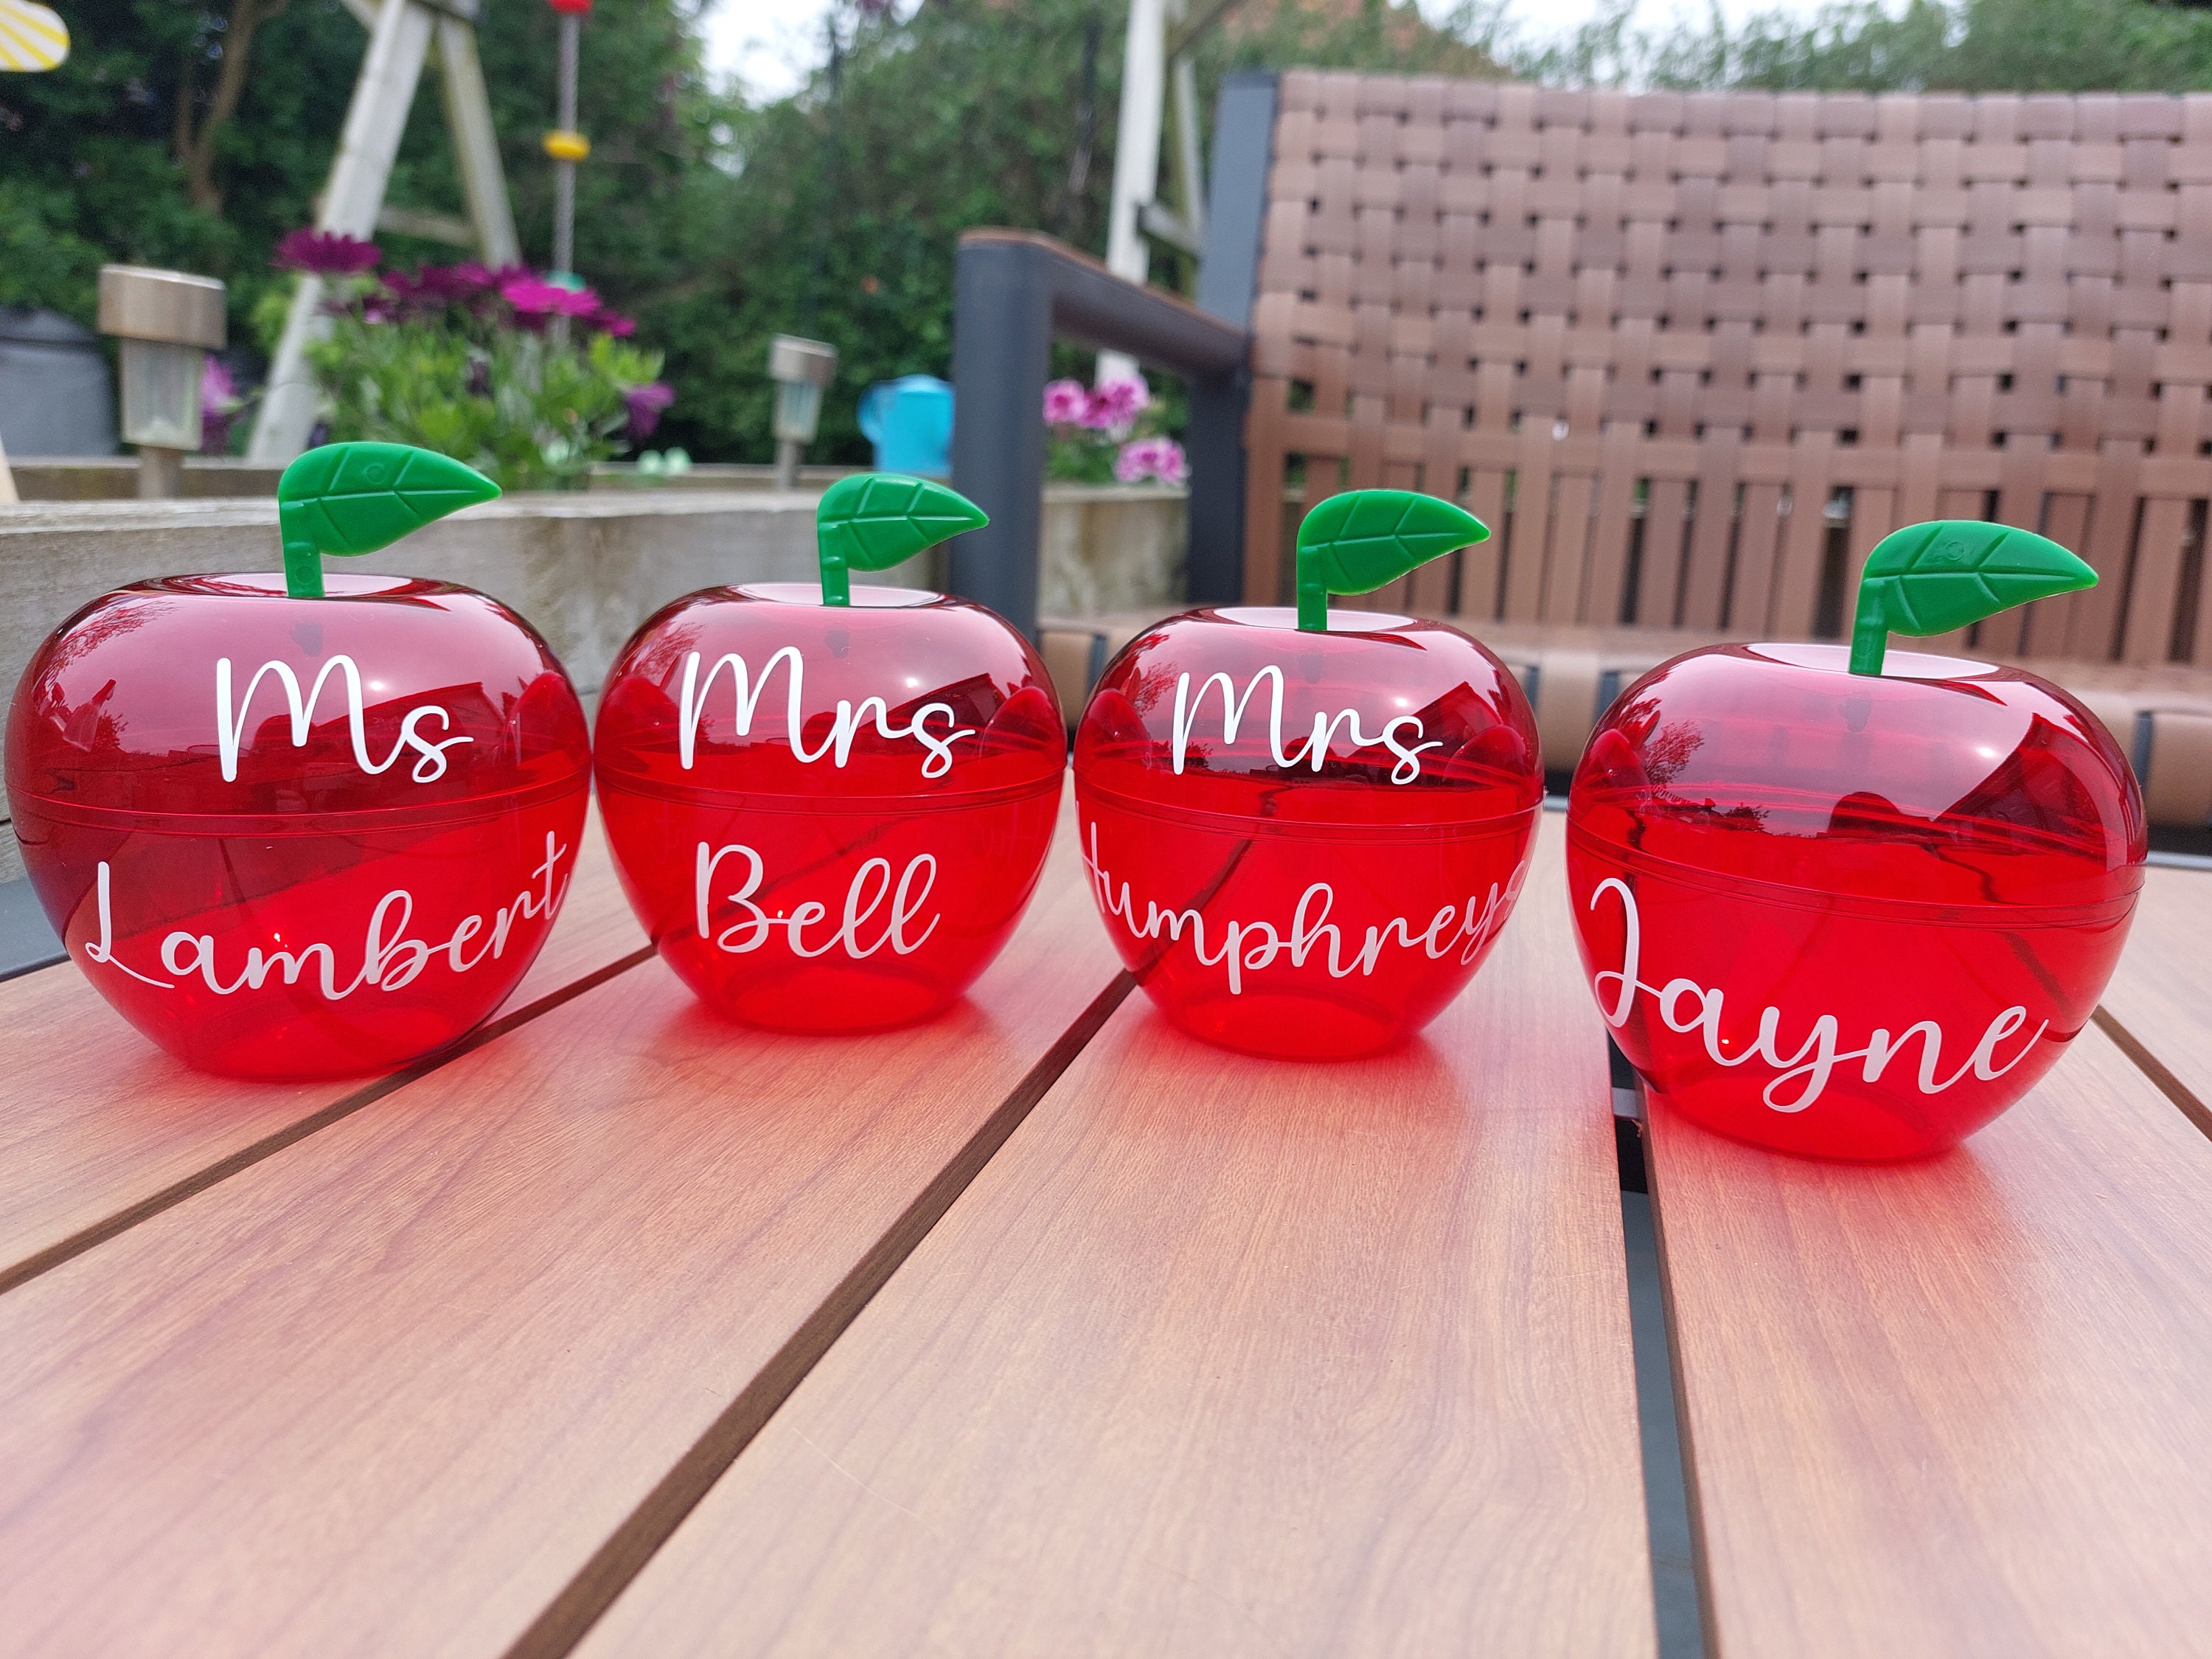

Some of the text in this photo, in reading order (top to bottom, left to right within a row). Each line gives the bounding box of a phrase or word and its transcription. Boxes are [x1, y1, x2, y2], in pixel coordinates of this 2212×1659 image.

[216, 654, 474, 783] Ms
[679, 646, 976, 779] Mrs
[1172, 665, 1444, 785] Mrs
[86, 830, 568, 1001] Lambert
[696, 841, 941, 959] Bell
[1590, 877, 2050, 1113] Jayne
